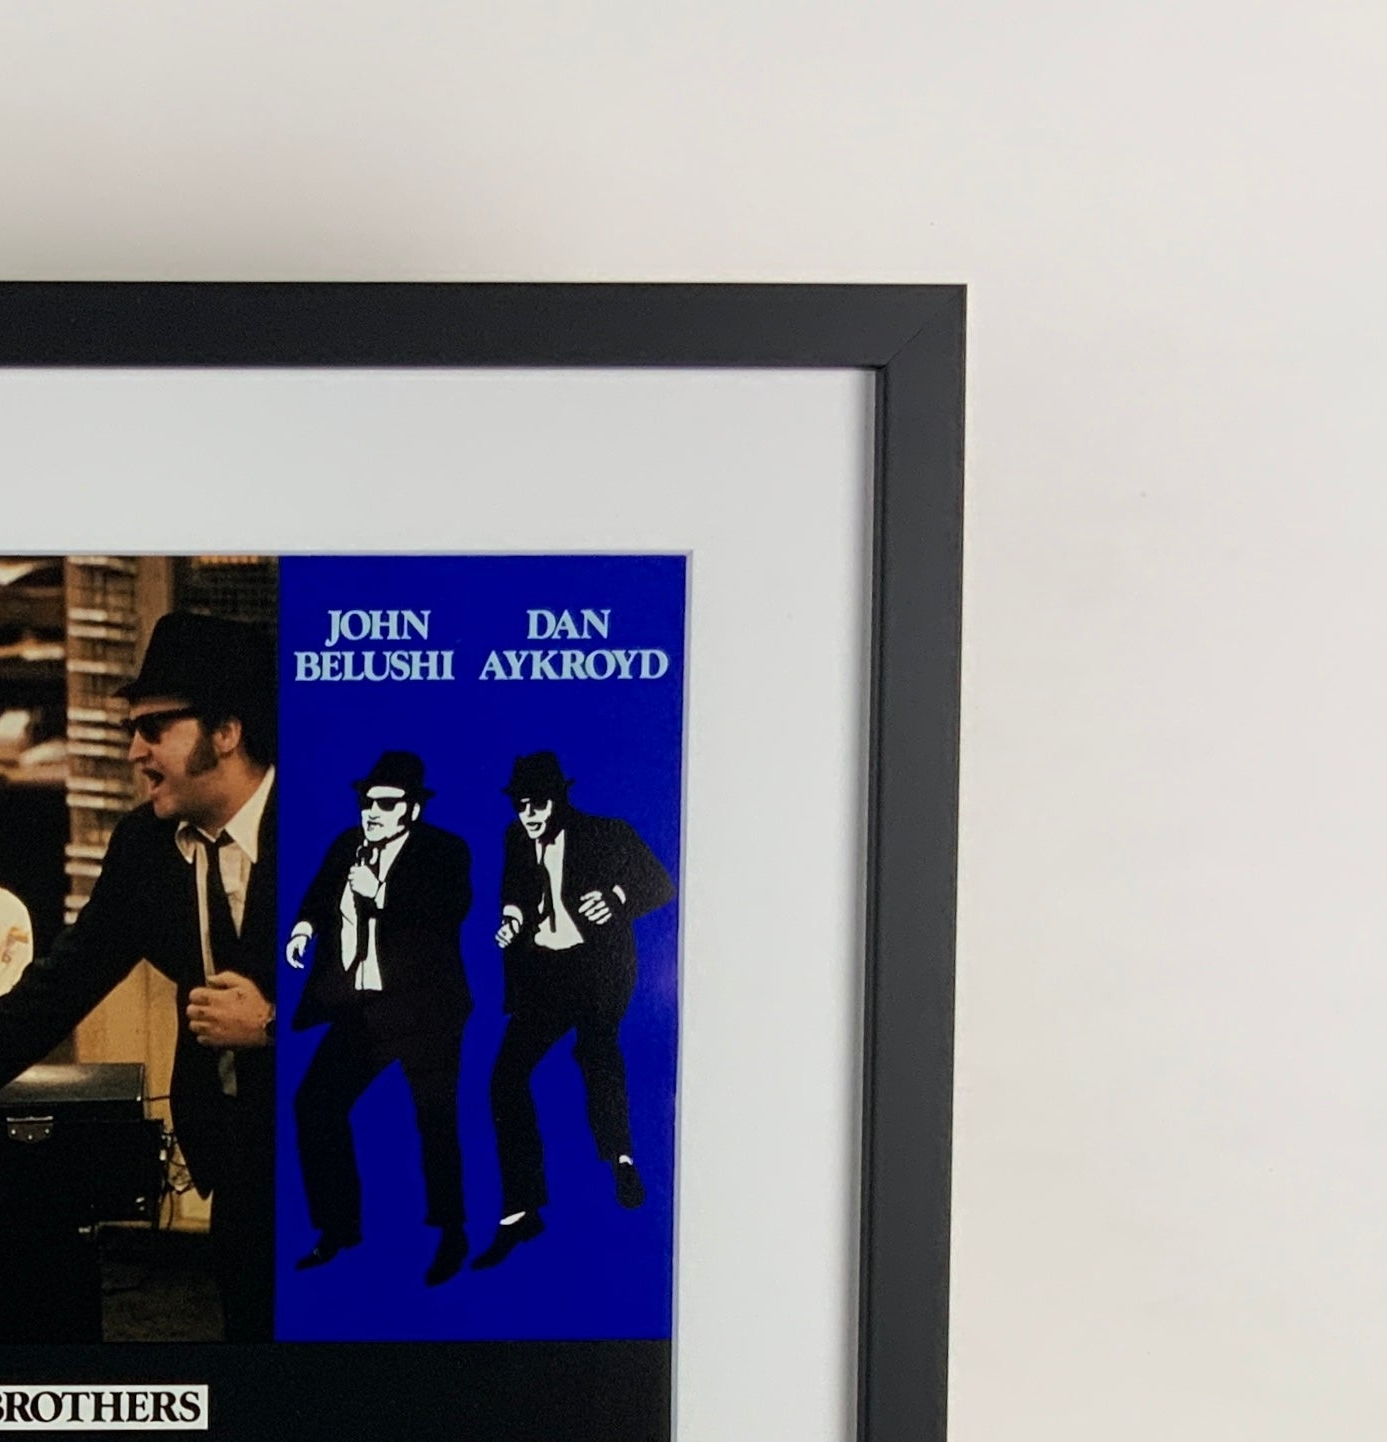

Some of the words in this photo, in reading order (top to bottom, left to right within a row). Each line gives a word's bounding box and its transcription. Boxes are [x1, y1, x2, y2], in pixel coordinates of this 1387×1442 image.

[325, 609, 432, 647] JOHN
[525, 608, 612, 640] DAN
[293, 649, 456, 682] BELUSHI
[478, 648, 669, 680] AYKROYD
